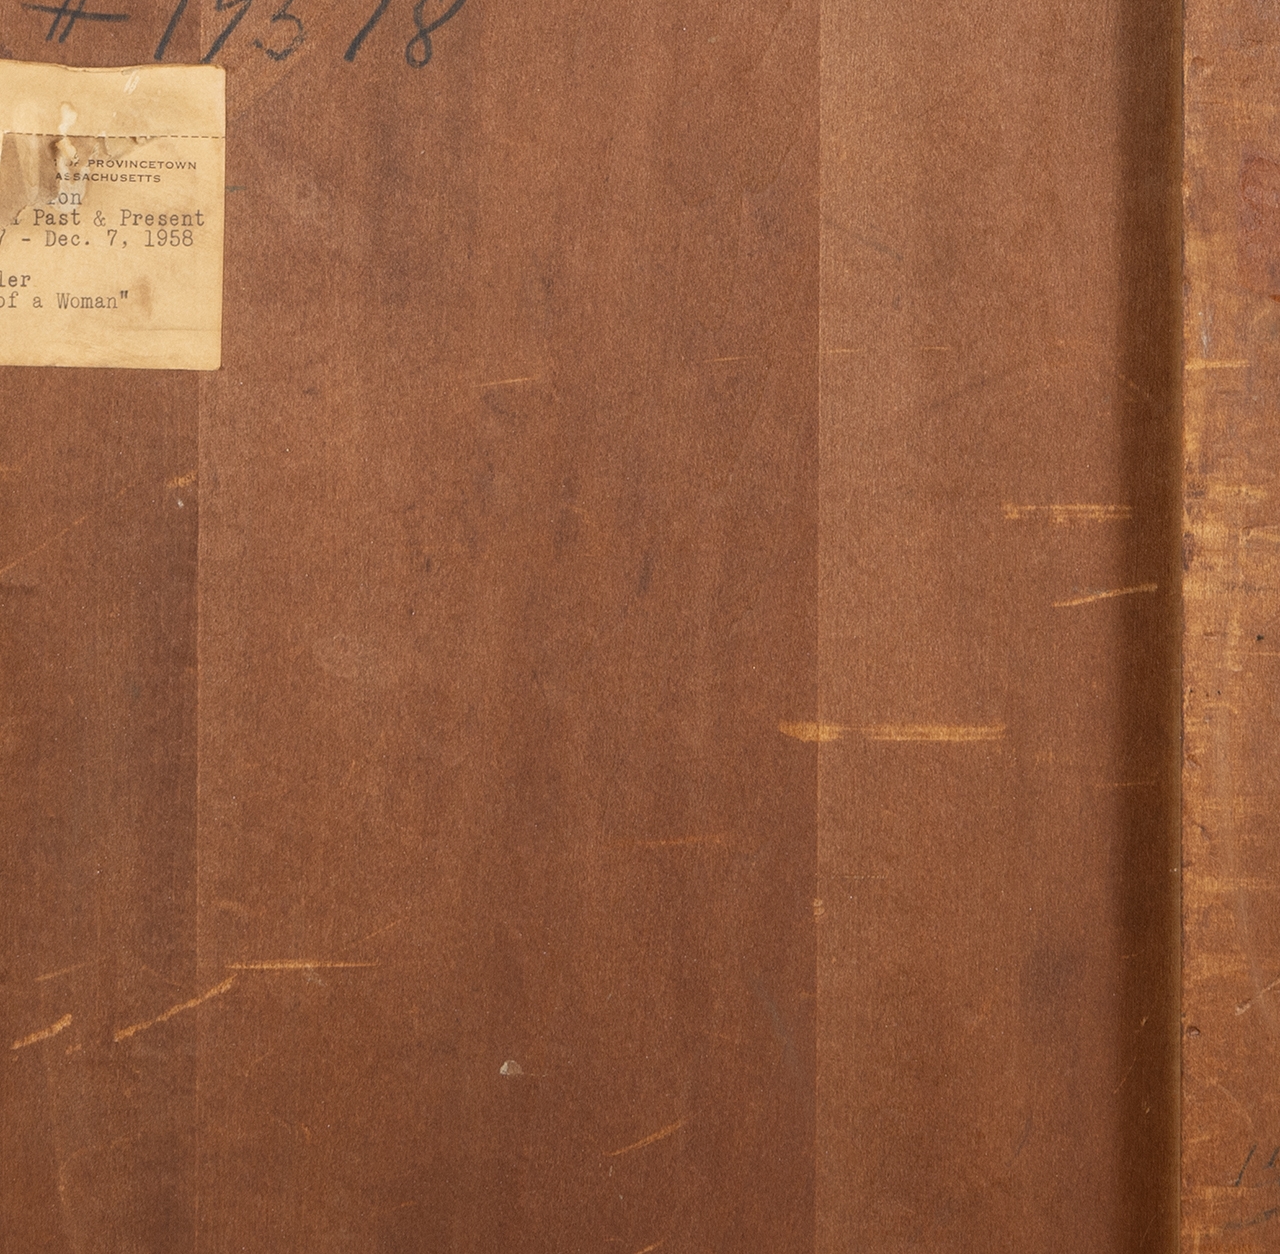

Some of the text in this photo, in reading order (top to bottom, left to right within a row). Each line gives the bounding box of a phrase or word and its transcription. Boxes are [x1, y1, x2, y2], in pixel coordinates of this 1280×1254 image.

[87, 158, 198, 170] PROVINCETOWN
[54, 172, 162, 183] ASSACHUSETTS
[32, 208, 81, 227] Past
[92, 209, 107, 228] &
[119, 208, 206, 227] Present
[44, 228, 91, 247] Dec.
[106, 228, 129, 249] 7,
[144, 228, 195, 248] 1958
[32, 295, 44, 309] a
[55, 289, 130, 310] Woman"
